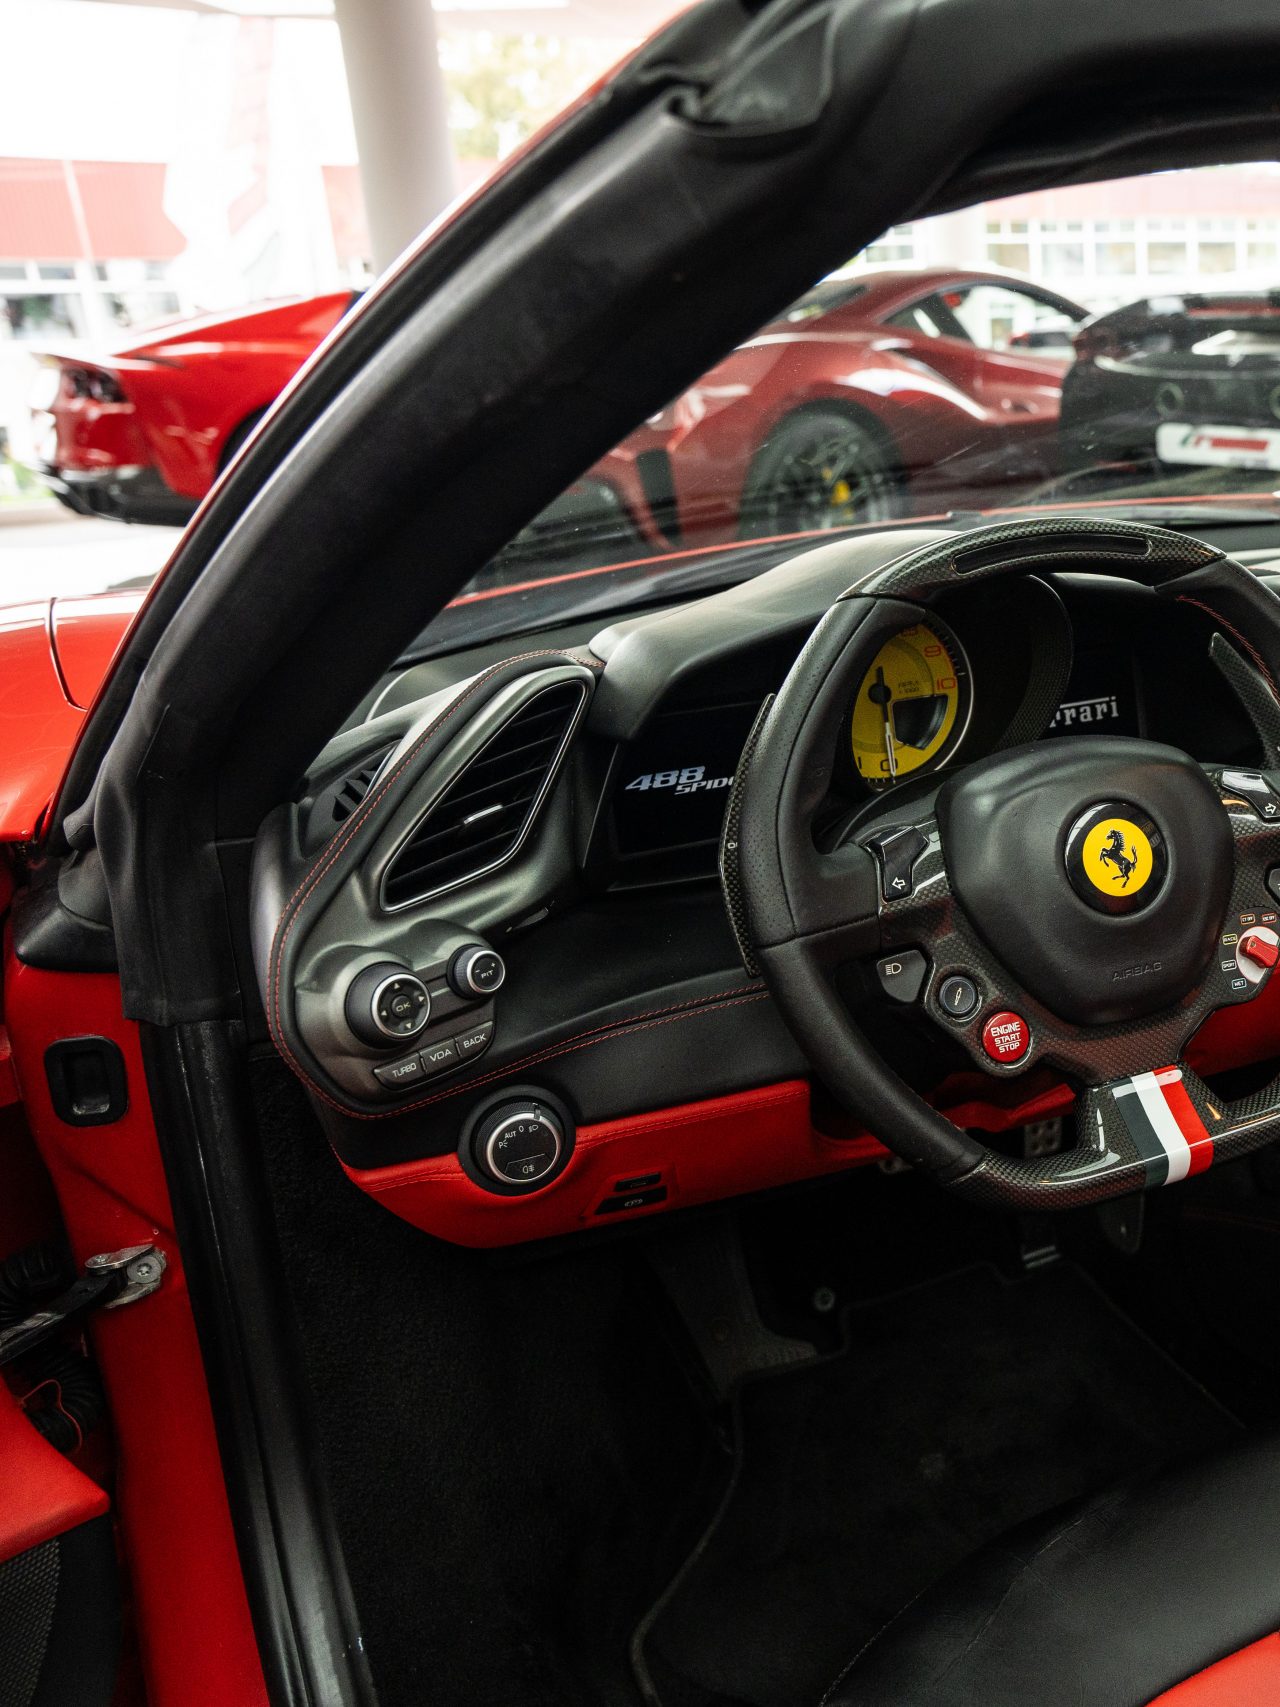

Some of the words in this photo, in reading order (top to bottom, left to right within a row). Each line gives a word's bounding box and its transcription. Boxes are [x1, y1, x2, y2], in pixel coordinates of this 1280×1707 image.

[936, 677, 956, 690] 10
[625, 765, 706, 791] 488
[481, 970, 494, 979] PIT
[1113, 962, 1162, 981] AIRBAG
[395, 1002, 411, 1012] OK
[990, 1021, 1021, 1037] ENGINE
[463, 1033, 487, 1049] BACK
[994, 1032, 1021, 1045] START
[999, 1042, 1020, 1053] STOP
[429, 1048, 453, 1062] VDA
[392, 1062, 417, 1078] TURBO
